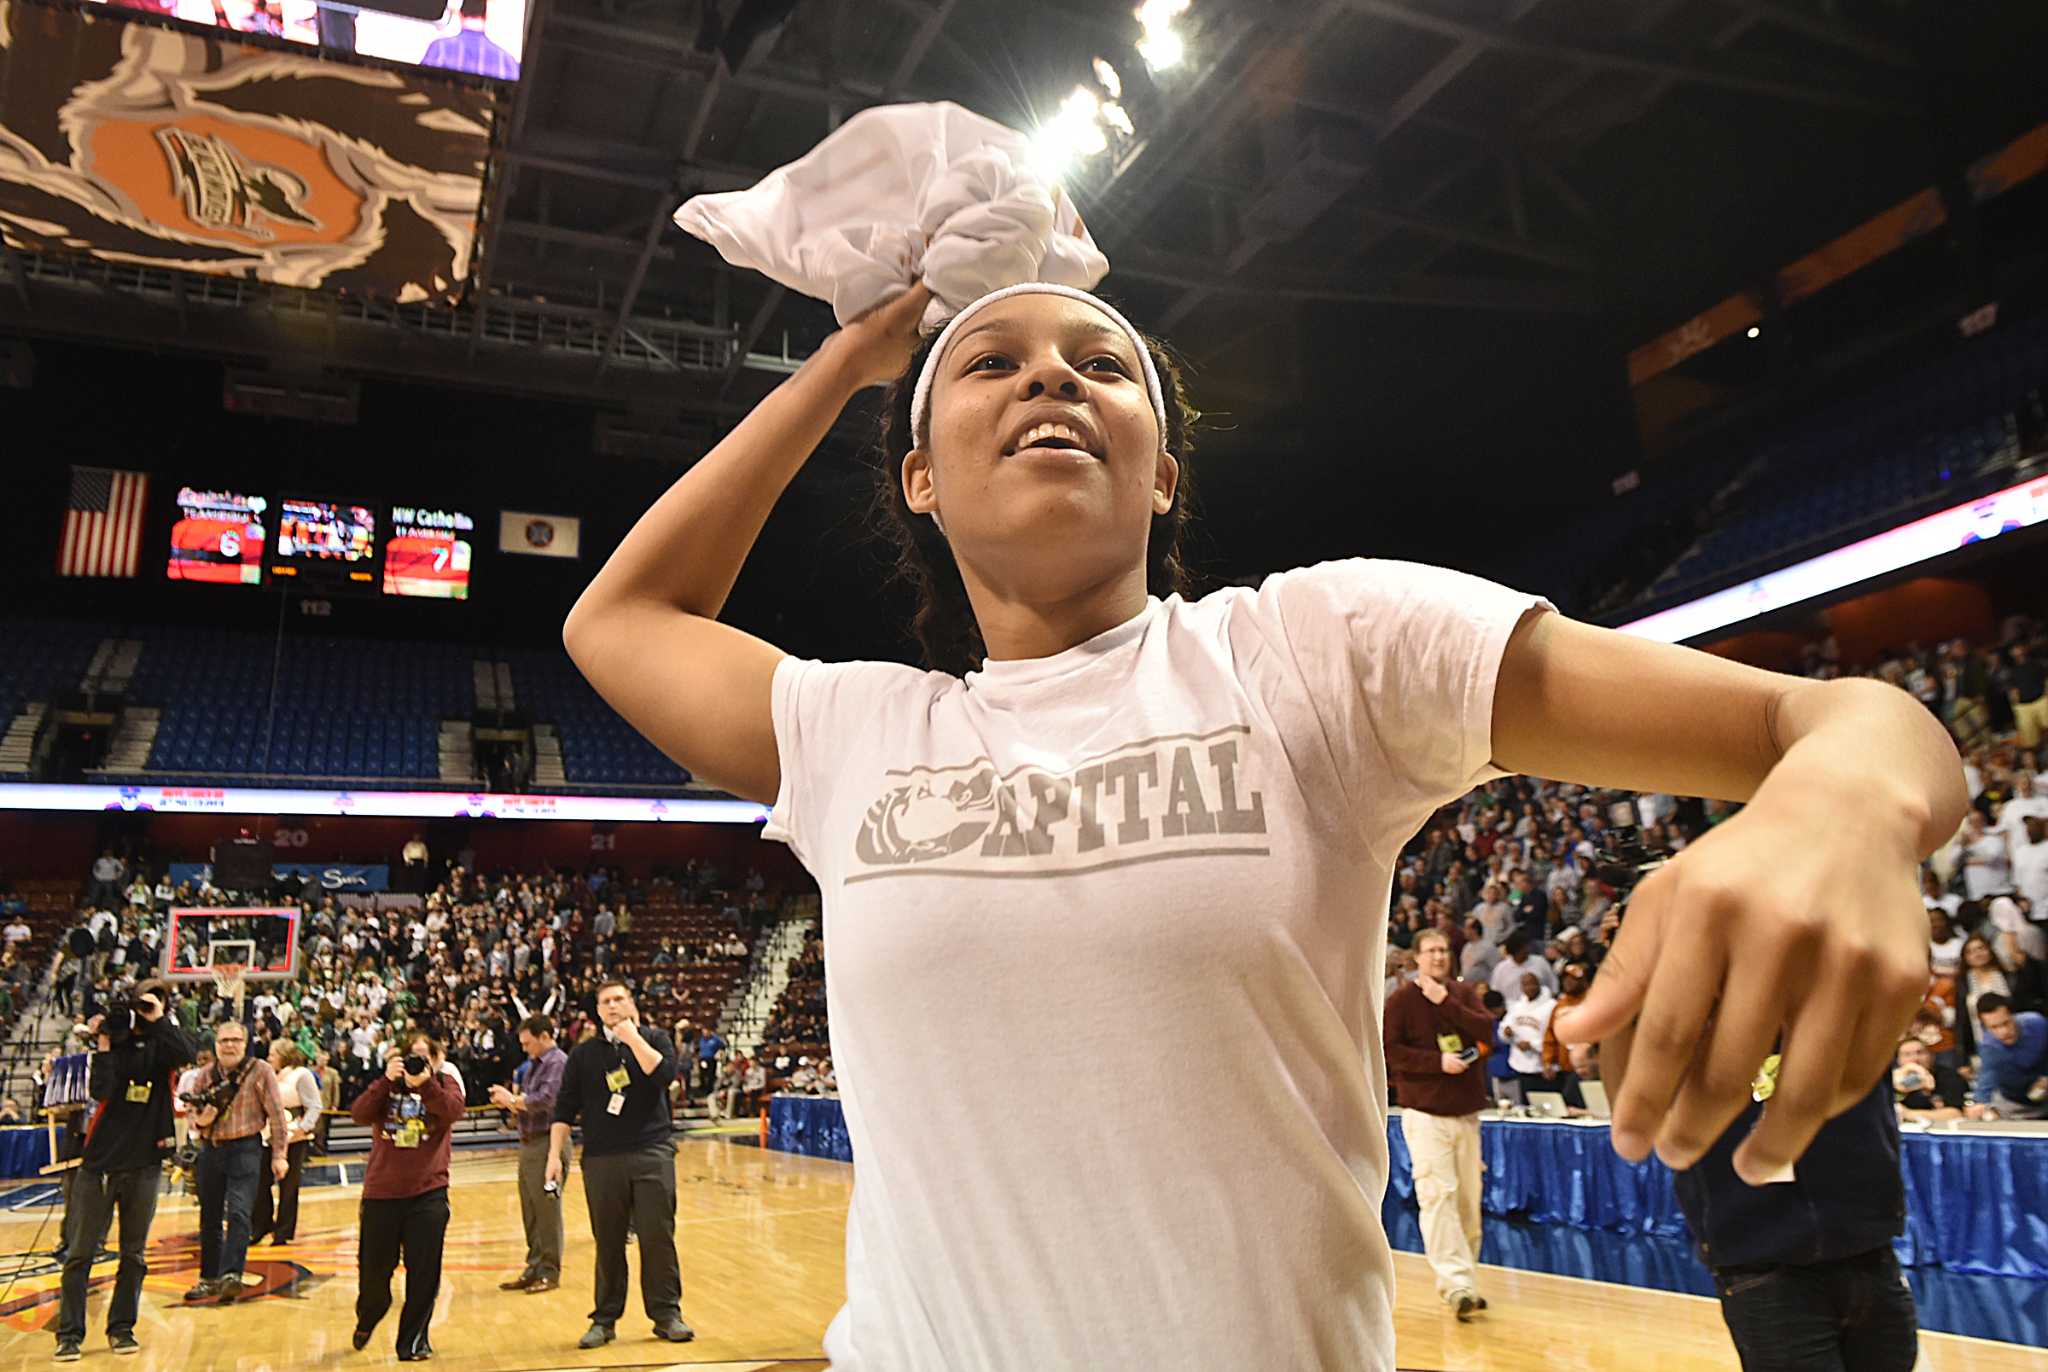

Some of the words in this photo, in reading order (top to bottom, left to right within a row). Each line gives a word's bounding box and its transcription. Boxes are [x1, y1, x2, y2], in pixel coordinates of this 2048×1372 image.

[392, 506, 416, 524] NW
[220, 530, 241, 557] 6
[432, 547, 449, 573] 7
[274, 829, 309, 847] 20
